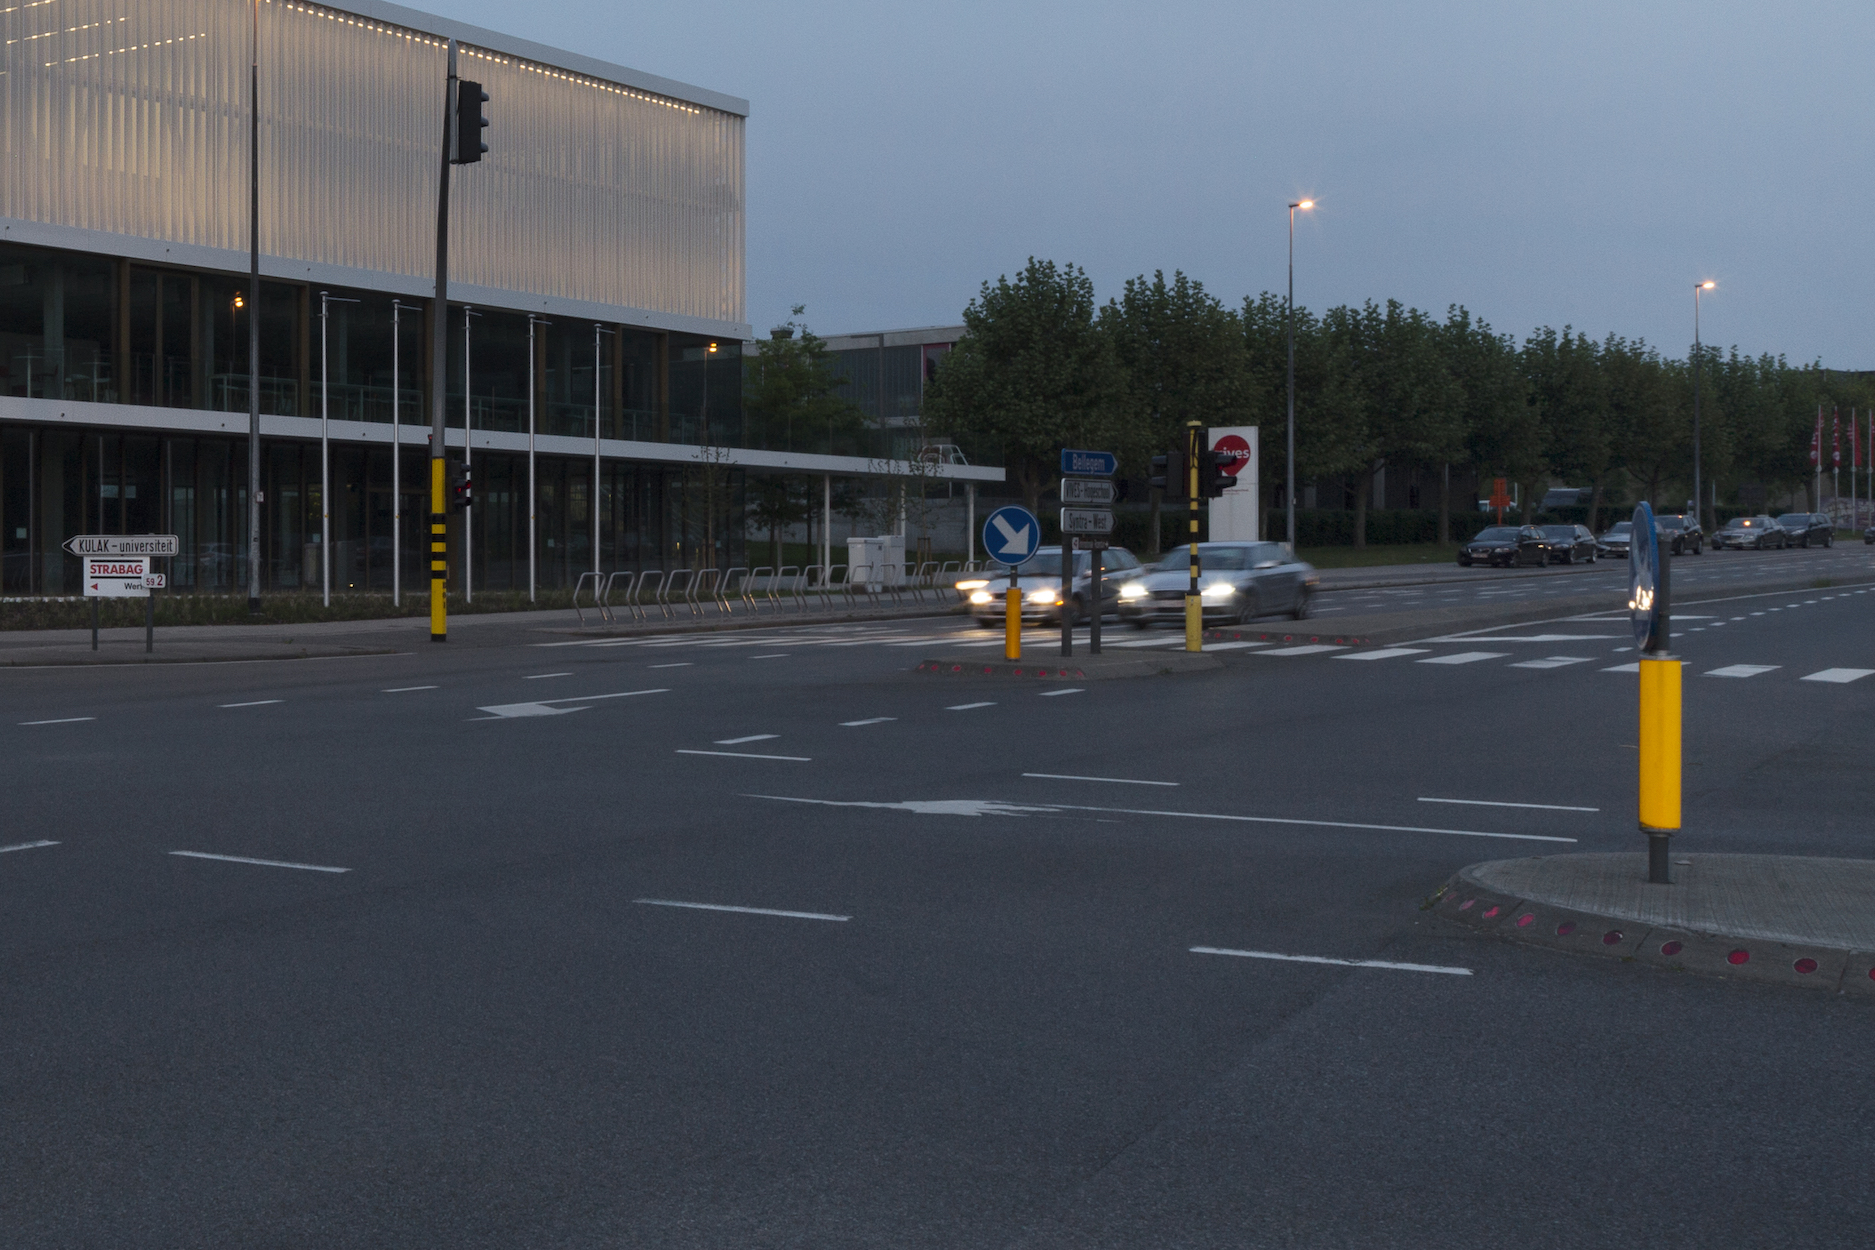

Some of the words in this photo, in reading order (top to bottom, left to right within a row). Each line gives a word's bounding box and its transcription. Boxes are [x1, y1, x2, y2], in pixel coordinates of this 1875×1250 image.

[1214, 446, 1250, 459] ives
[1072, 453, 1106, 475] Bellegem
[79, 539, 110, 553] KULAK
[119, 538, 173, 553] universiteit
[90, 564, 144, 575] STRABAG
[157, 574, 163, 586] 2
